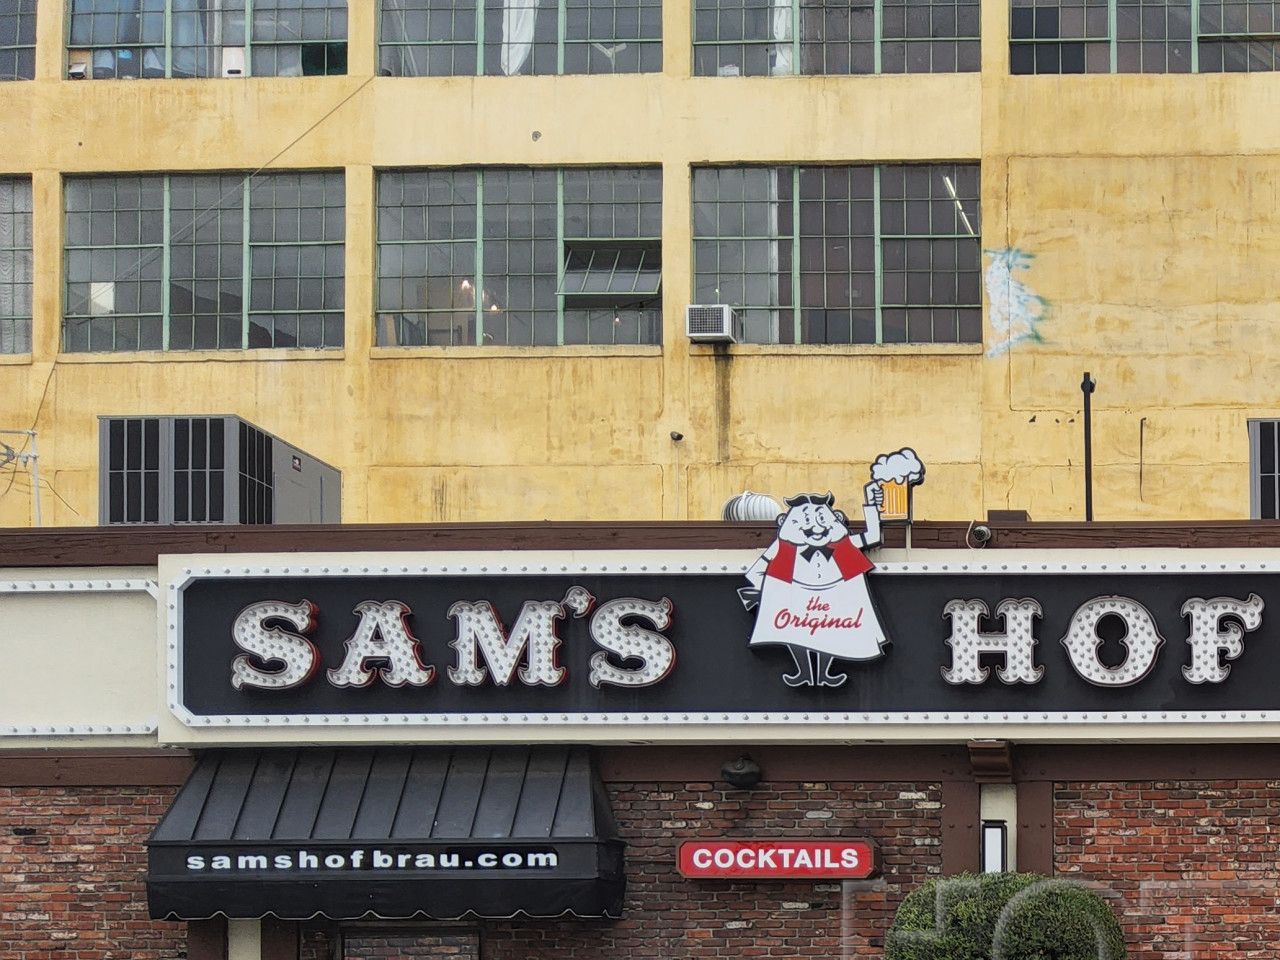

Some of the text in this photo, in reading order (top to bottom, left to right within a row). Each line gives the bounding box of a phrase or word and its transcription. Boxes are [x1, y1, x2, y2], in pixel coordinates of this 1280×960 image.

[806, 596, 830, 612] the
[774, 608, 863, 635] Original
[231, 585, 676, 690] SAM'S
[941, 593, 1265, 687] HOF
[186, 849, 559, 870] samshofbrau.com
[693, 848, 858, 869] COCKTAILS
